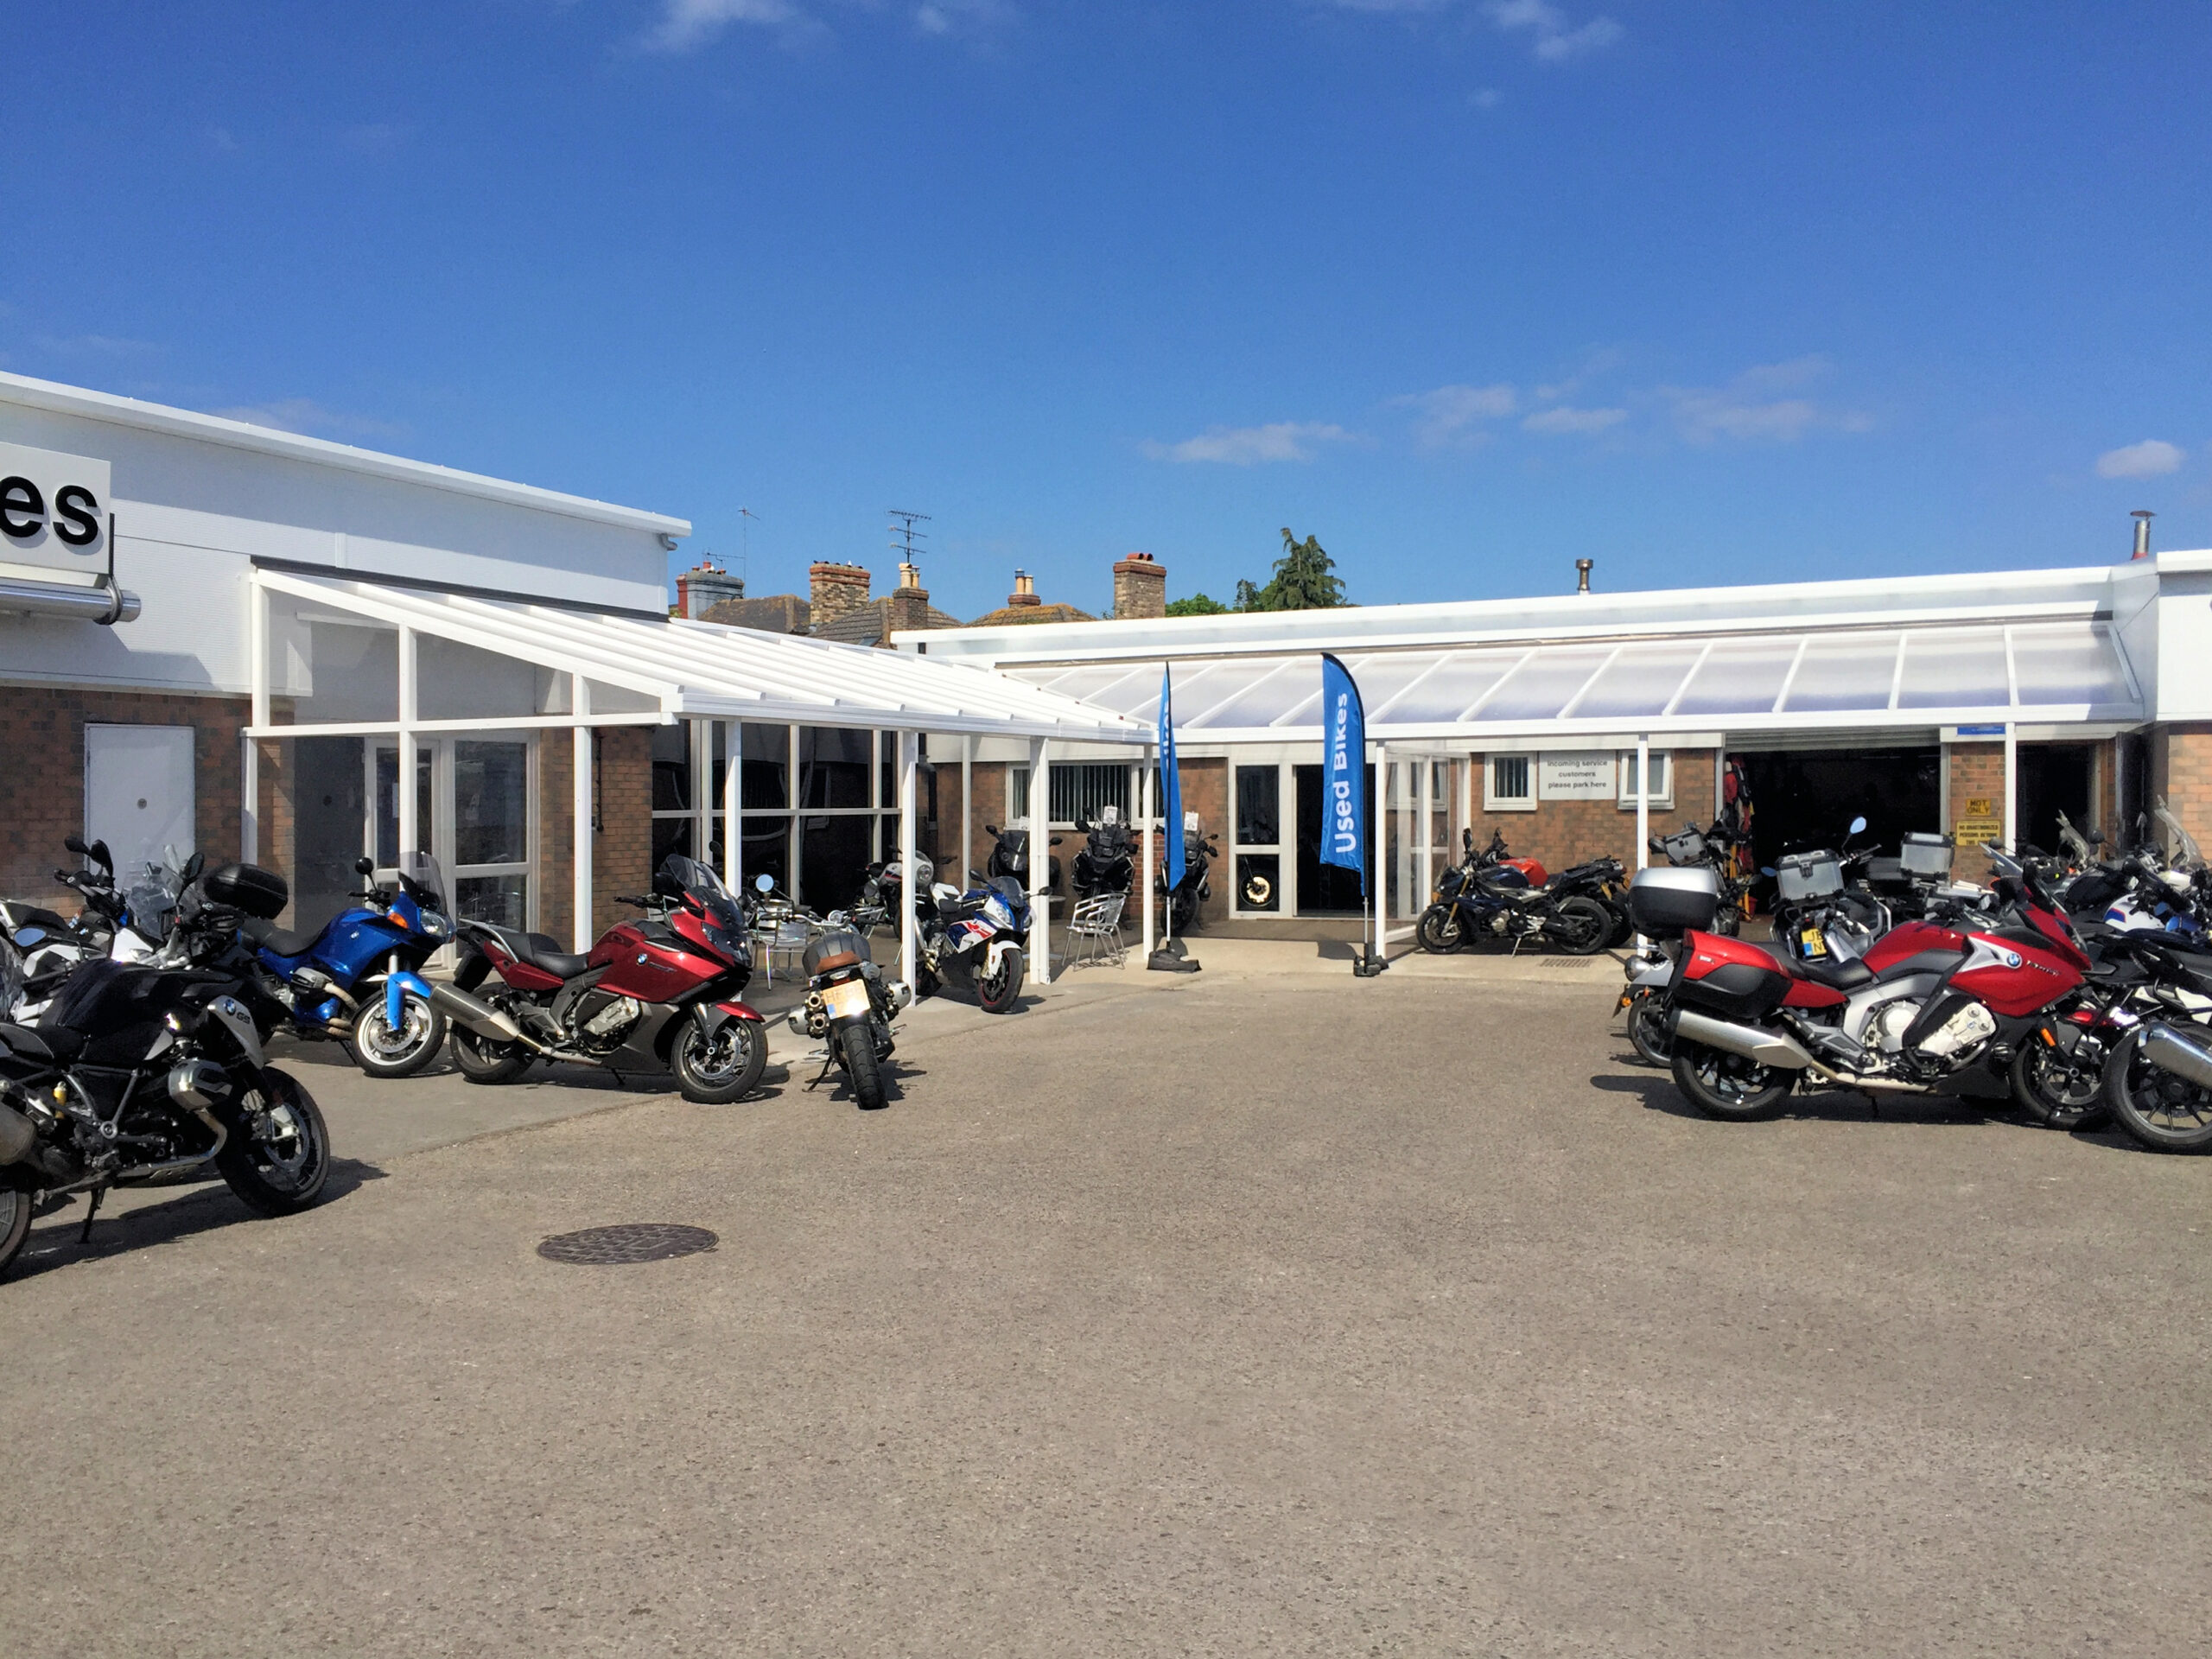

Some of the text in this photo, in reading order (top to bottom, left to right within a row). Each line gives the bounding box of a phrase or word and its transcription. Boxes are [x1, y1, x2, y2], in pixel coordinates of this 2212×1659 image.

[0, 476, 99, 545] es
[1333, 693, 1357, 854] Used Bikes
[1548, 781, 1572, 790] please
[236, 1011, 251, 1025] GS
